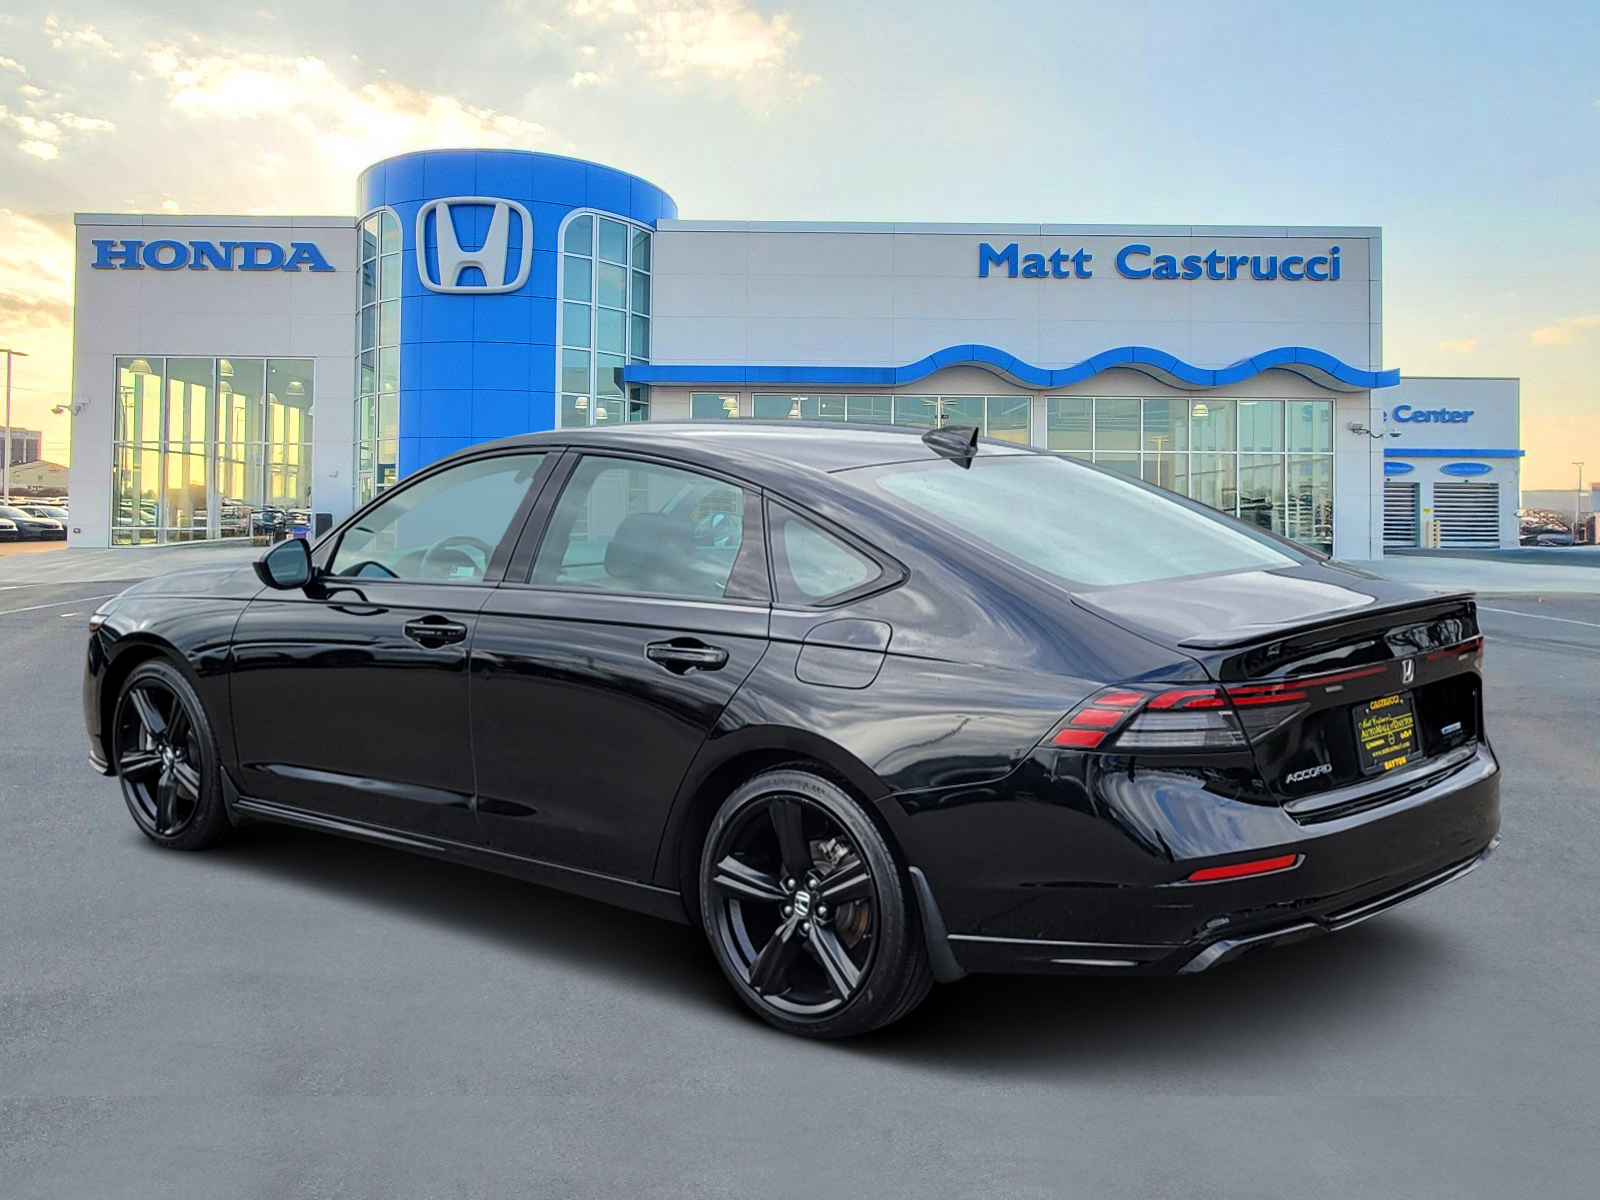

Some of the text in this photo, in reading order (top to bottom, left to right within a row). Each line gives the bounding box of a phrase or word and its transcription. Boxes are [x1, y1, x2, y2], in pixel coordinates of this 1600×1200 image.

[91, 239, 335, 273] HONDA
[978, 242, 1342, 281] Matt Castrucci
[1392, 404, 1475, 424] Center
[1286, 763, 1332, 784] ACCORD
